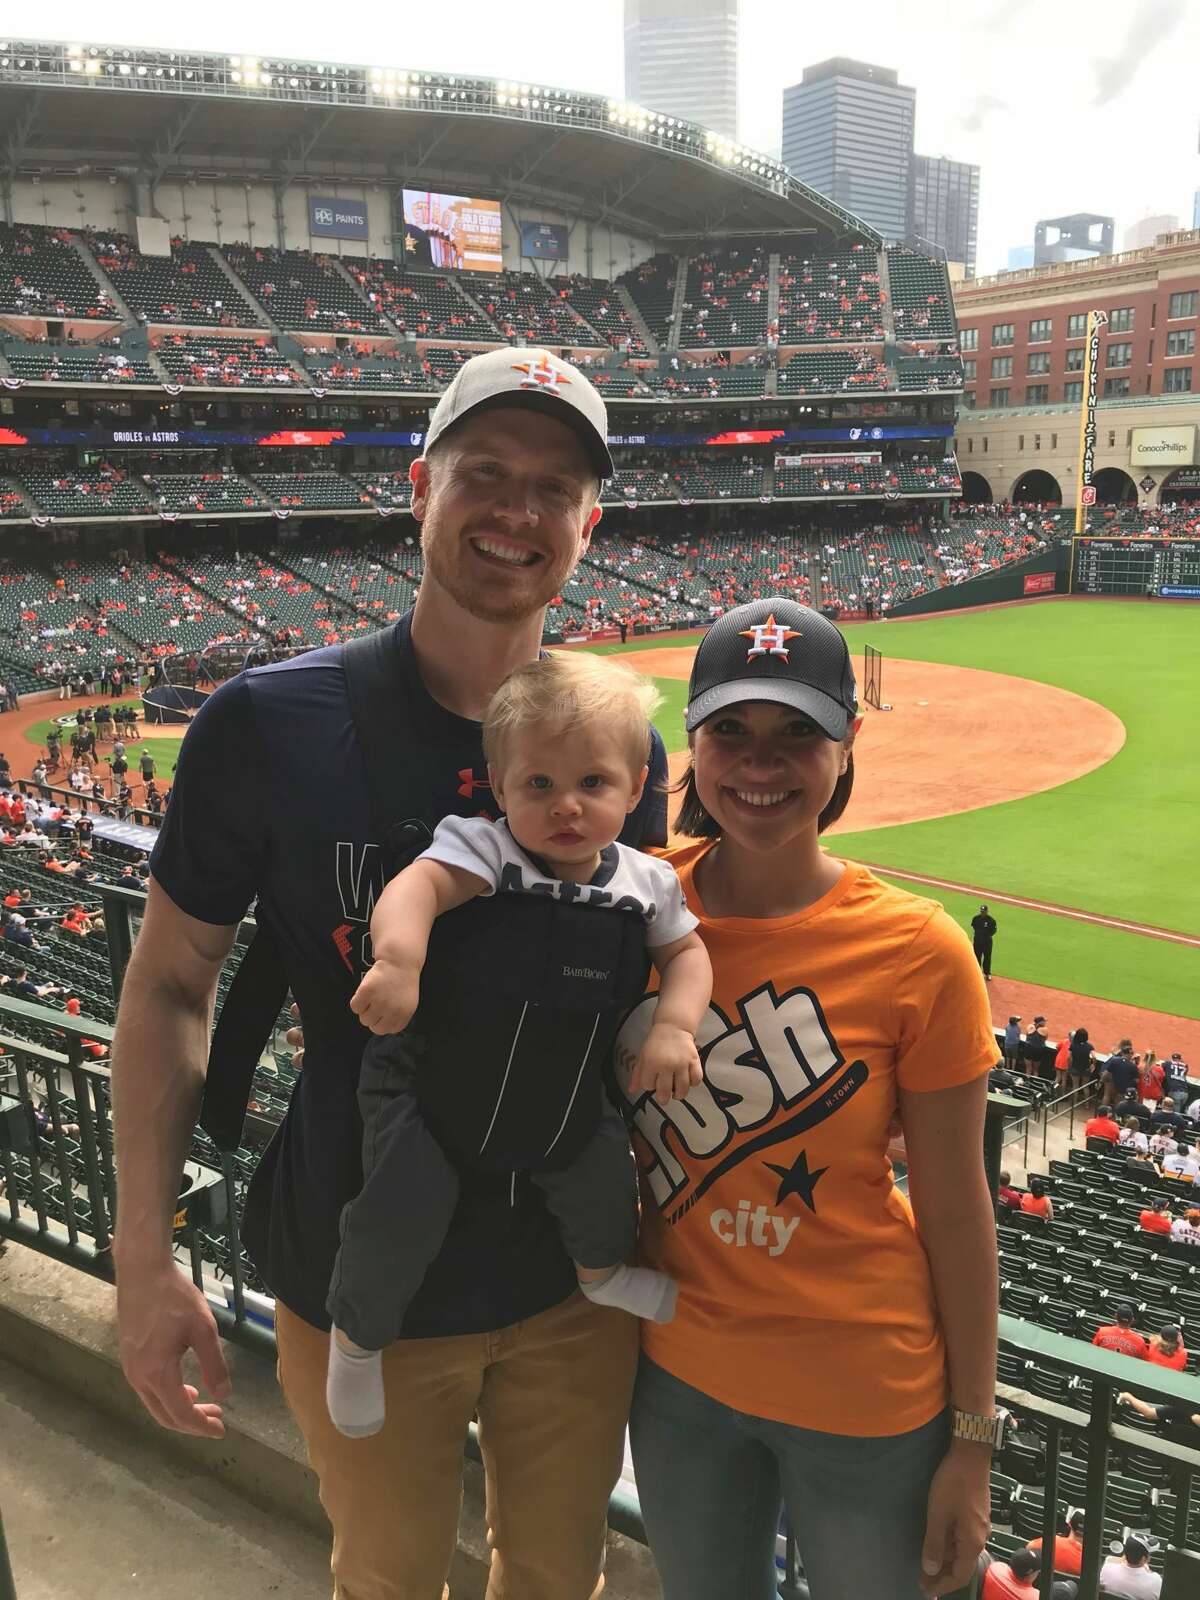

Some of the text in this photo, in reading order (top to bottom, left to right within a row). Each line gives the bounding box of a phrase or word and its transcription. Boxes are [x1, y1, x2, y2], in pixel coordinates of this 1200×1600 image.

[335, 213, 364, 225] PAINTS
[1088, 338, 1099, 407] CHIKIN
[113, 431, 143, 442] ORIOLES
[152, 432, 179, 442] ASTROS
[1137, 443, 1188, 453] ConocoPhillips
[1083, 436, 1093, 485] FARE
[710, 1200, 800, 1256] city
